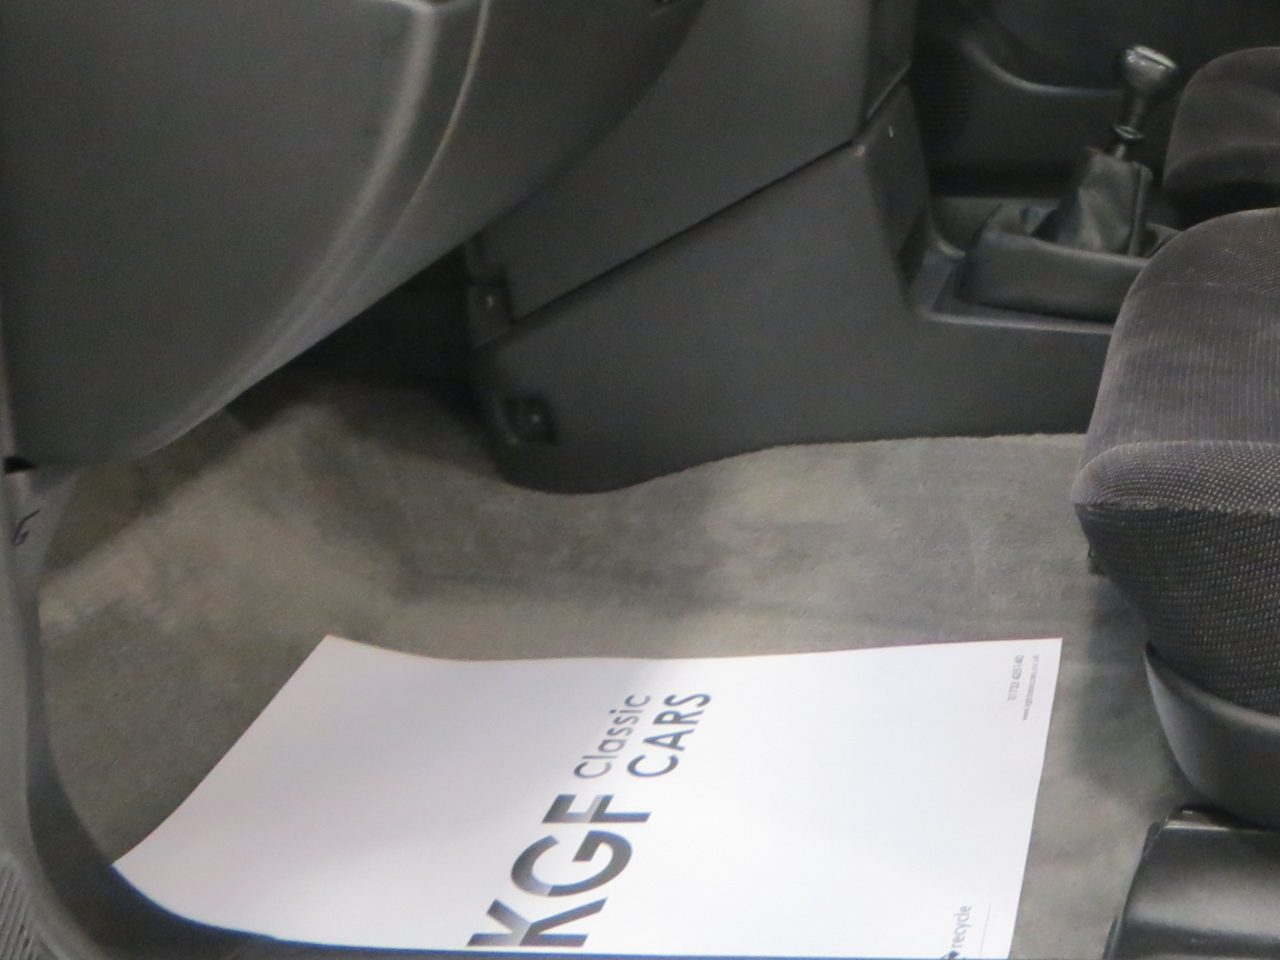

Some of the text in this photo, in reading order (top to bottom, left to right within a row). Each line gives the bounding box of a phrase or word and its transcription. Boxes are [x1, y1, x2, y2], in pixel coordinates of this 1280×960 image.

[572, 693, 652, 779] Classic
[626, 692, 712, 778] CARS
[466, 793, 652, 948] KGF
[951, 904, 973, 948] recycle
